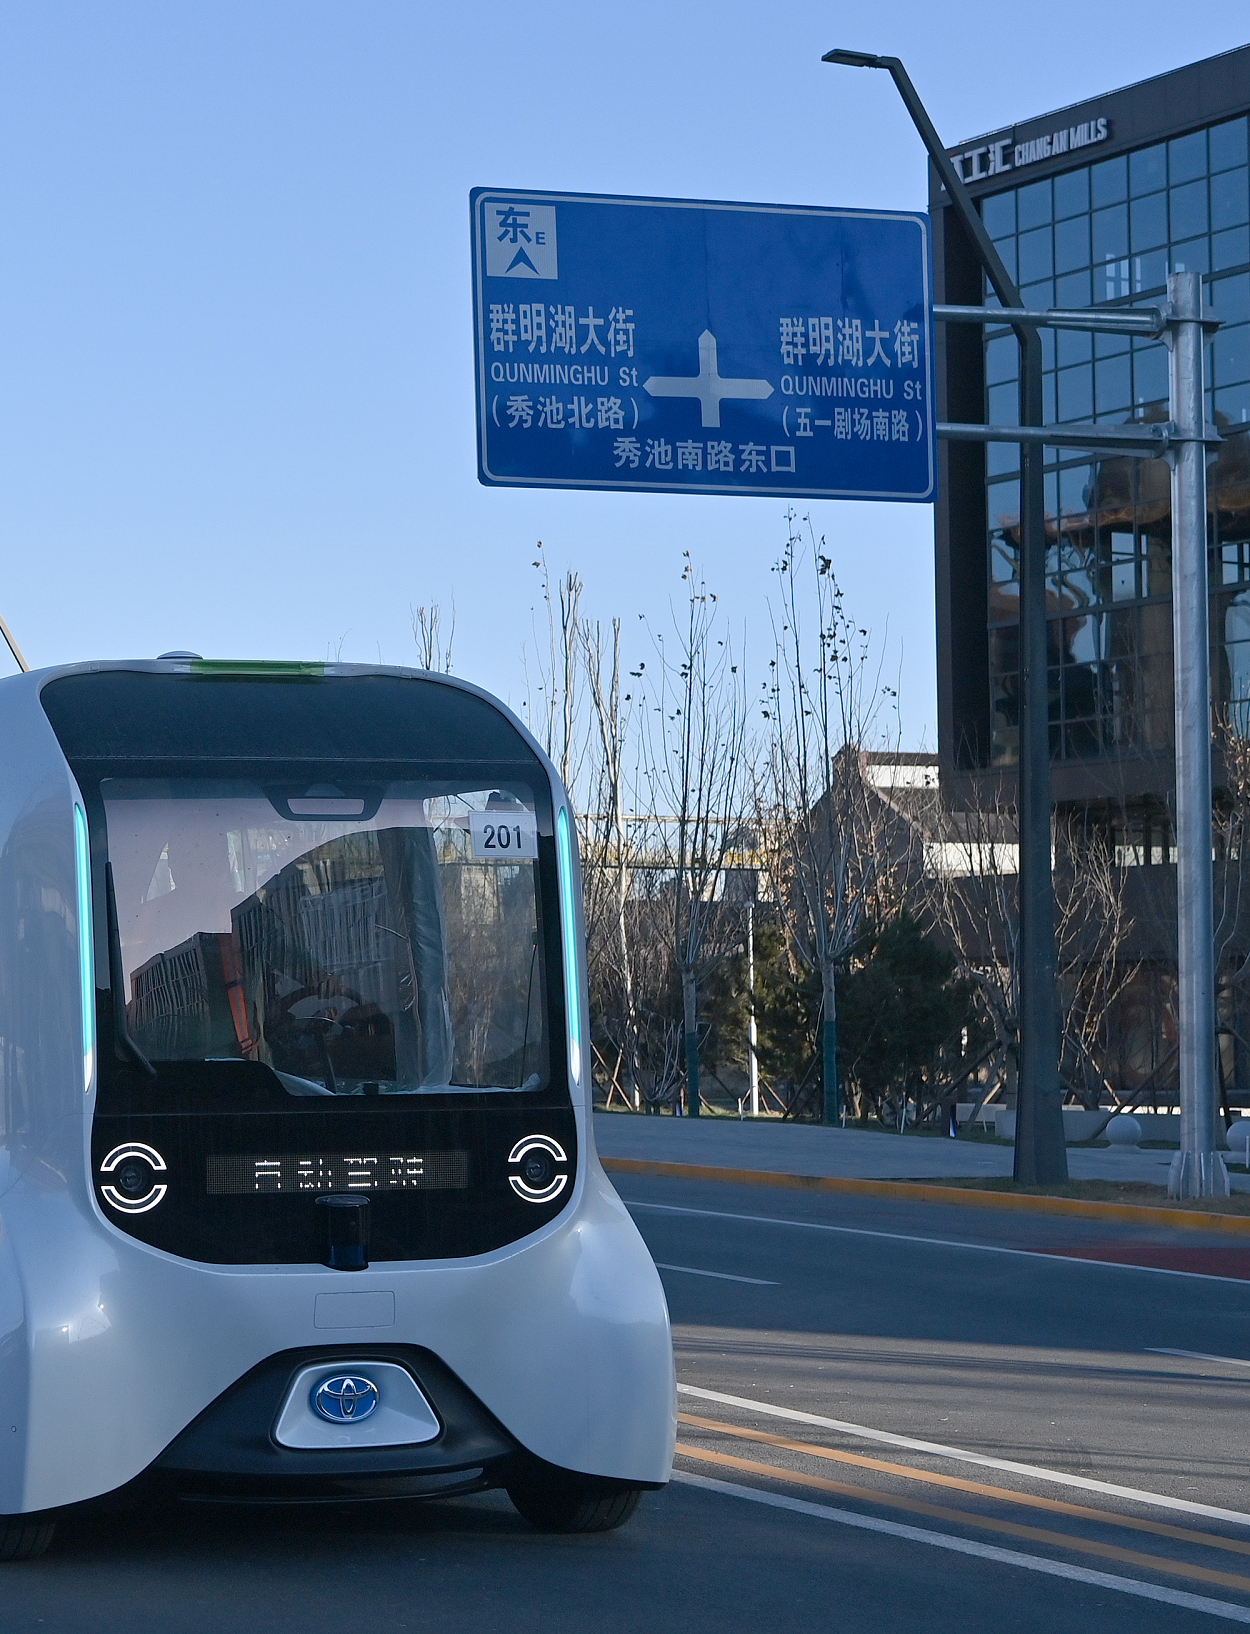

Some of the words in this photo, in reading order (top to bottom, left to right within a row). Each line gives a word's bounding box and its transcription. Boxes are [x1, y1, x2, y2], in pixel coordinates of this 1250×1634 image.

[1070, 117, 1108, 150] MILLS
[941, 139, 1012, 190] 工汇
[496, 206, 532, 244] 东
[535, 231, 546, 245] E
[489, 303, 636, 358] 群明湖大街
[779, 317, 920, 369] 群明湖大街
[491, 362, 609, 386] QUNMINGHU
[619, 367, 639, 387] St
[780, 375, 894, 399] QUNMINGHU
[903, 380, 923, 401] St
[613, 436, 796, 474] 秀池南路东口
[483, 824, 522, 849] 201
